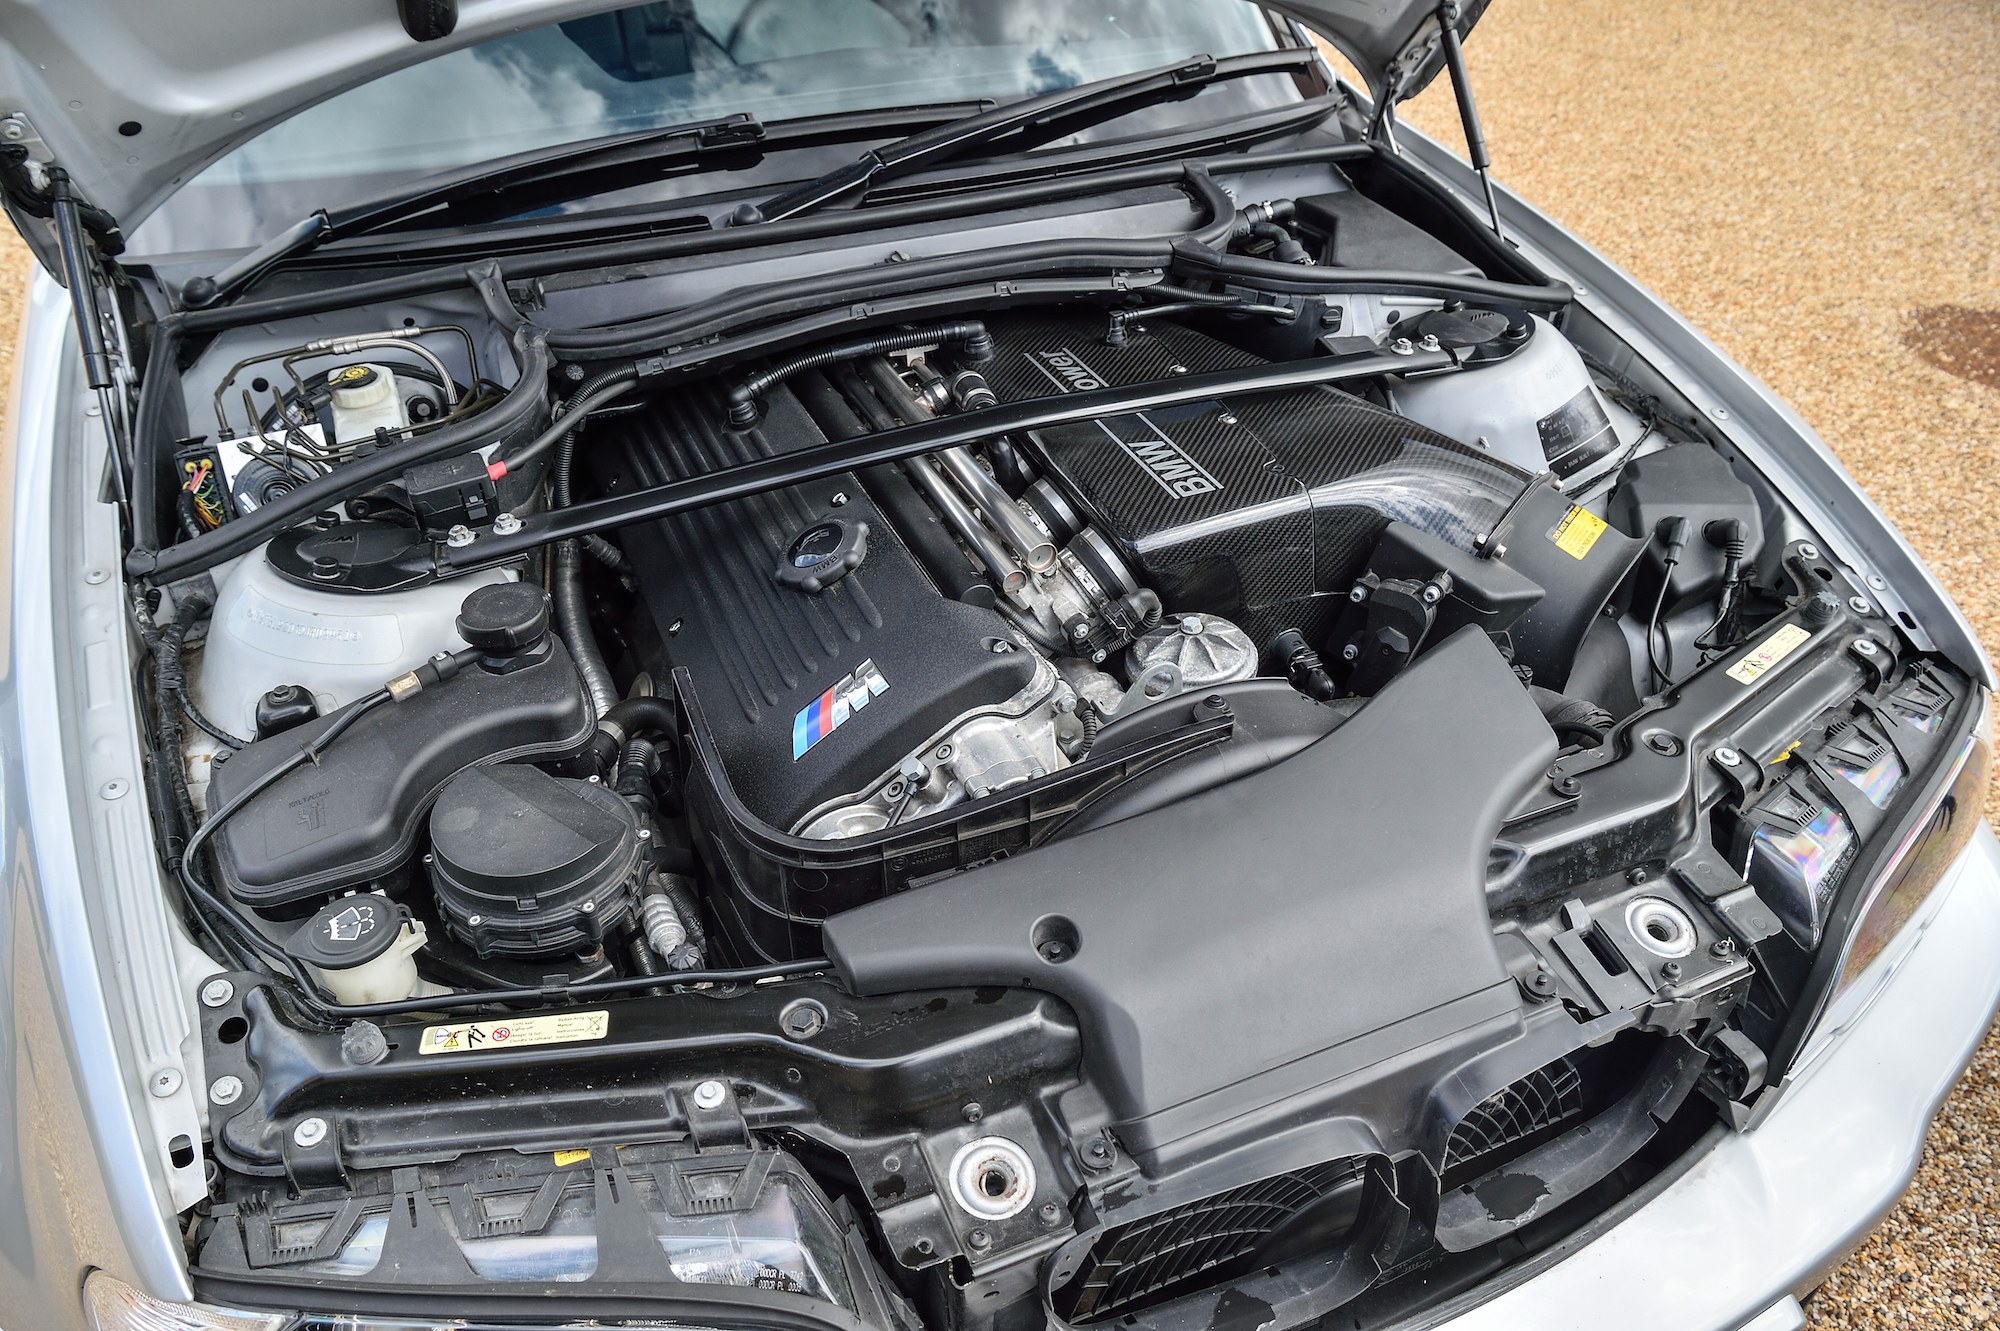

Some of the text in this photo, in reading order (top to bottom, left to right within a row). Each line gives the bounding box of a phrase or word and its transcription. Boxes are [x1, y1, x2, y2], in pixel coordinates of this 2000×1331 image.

[1039, 350, 1100, 391] ower
[1127, 440, 1216, 498] BMW
[811, 554, 838, 574] BMW
